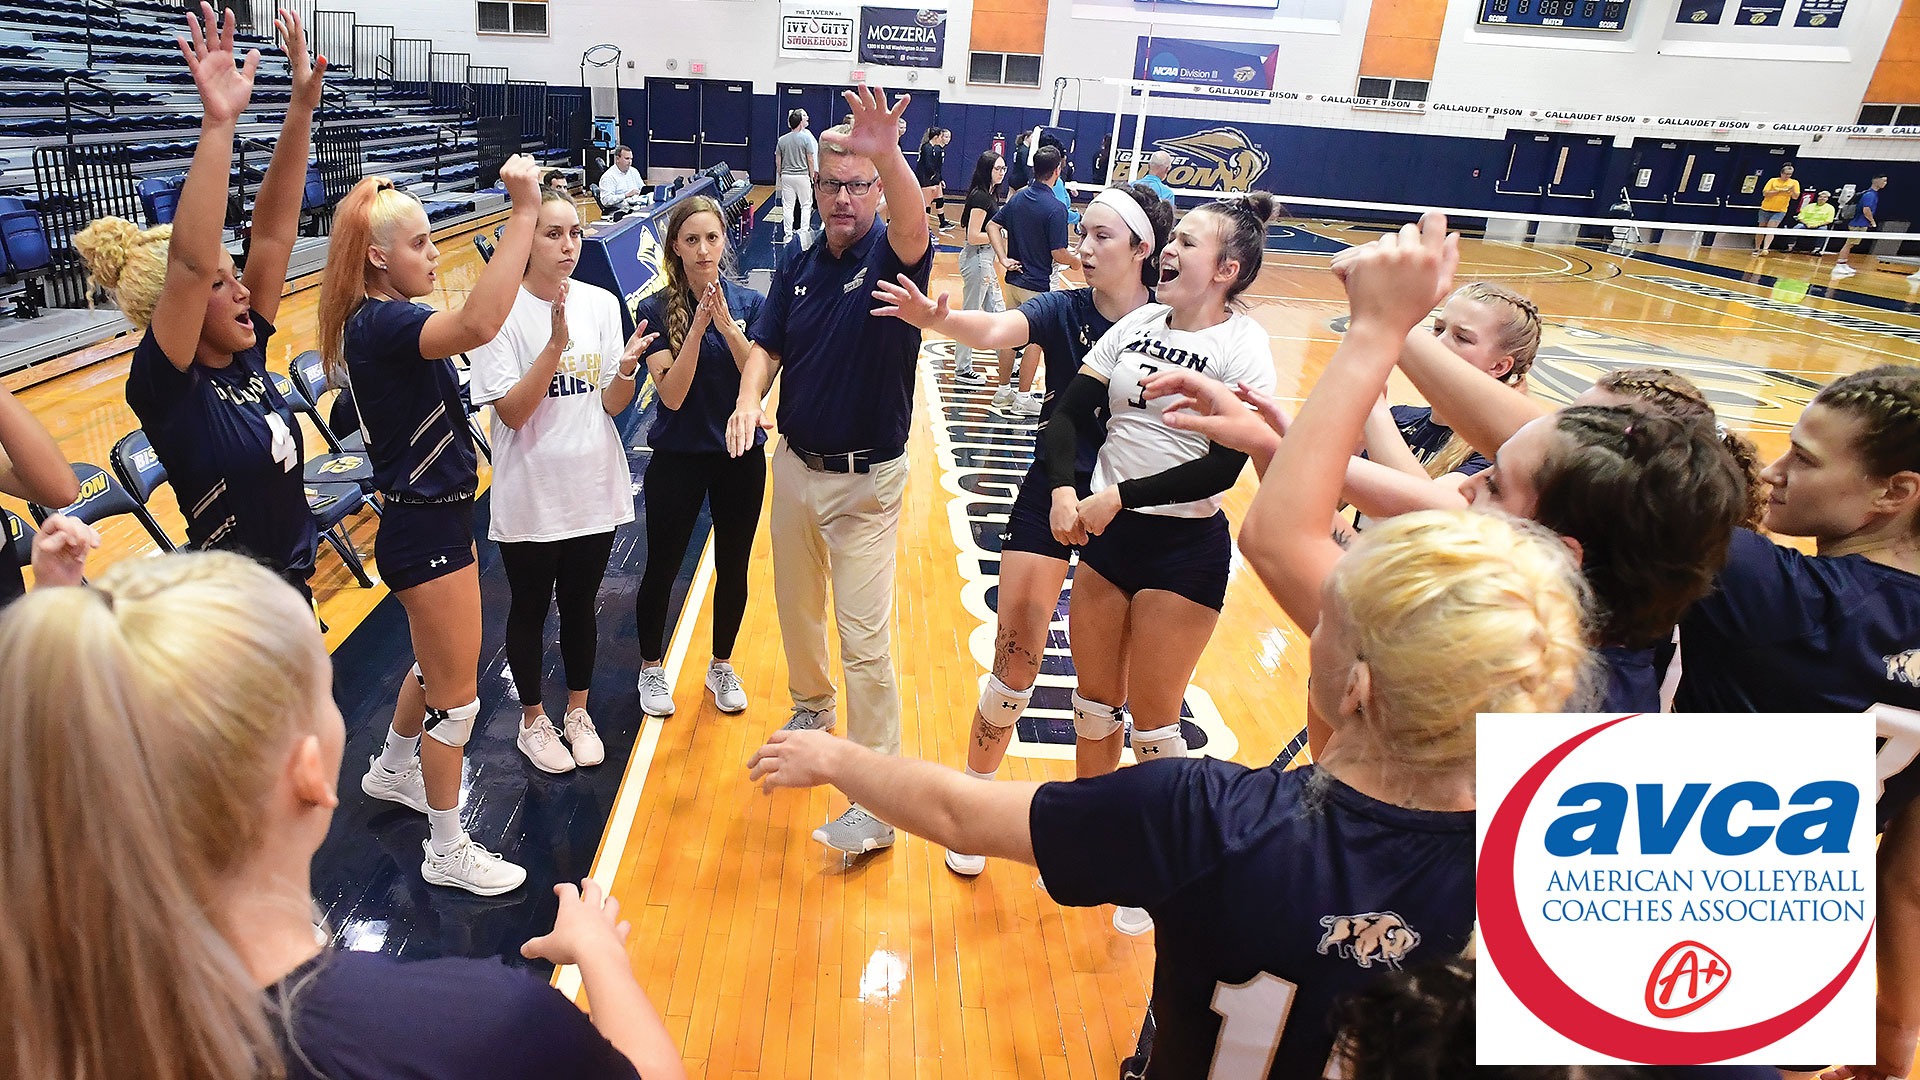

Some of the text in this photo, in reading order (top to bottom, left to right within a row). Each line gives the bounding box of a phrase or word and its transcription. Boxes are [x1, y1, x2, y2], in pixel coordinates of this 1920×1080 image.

[1488, 14, 1508, 23] SCORE
[1542, 18, 1564, 26] MATCH
[1599, 20, 1619, 29] SCORE
[787, 21, 850, 35] IVY CITY
[867, 25, 937, 43] MOZZERIA
[787, 35, 848, 47] SMOKEHOUSE
[1152, 66, 1179, 76] NCAA
[1180, 68, 1210, 78] Division
[1208, 86, 1299, 100] GALLAUDET BISON
[1320, 95, 1411, 108] GALLAUDET BISON
[1433, 103, 1523, 116] GALLAUDET BISON
[1545, 111, 1636, 123] GALLAUDET BISON
[1657, 117, 1750, 129] GALLAUDET BISON
[1772, 123, 1868, 134] GALLAUDET BISON
[264, 410, 298, 474] 4
[134, 447, 159, 470] BIS
